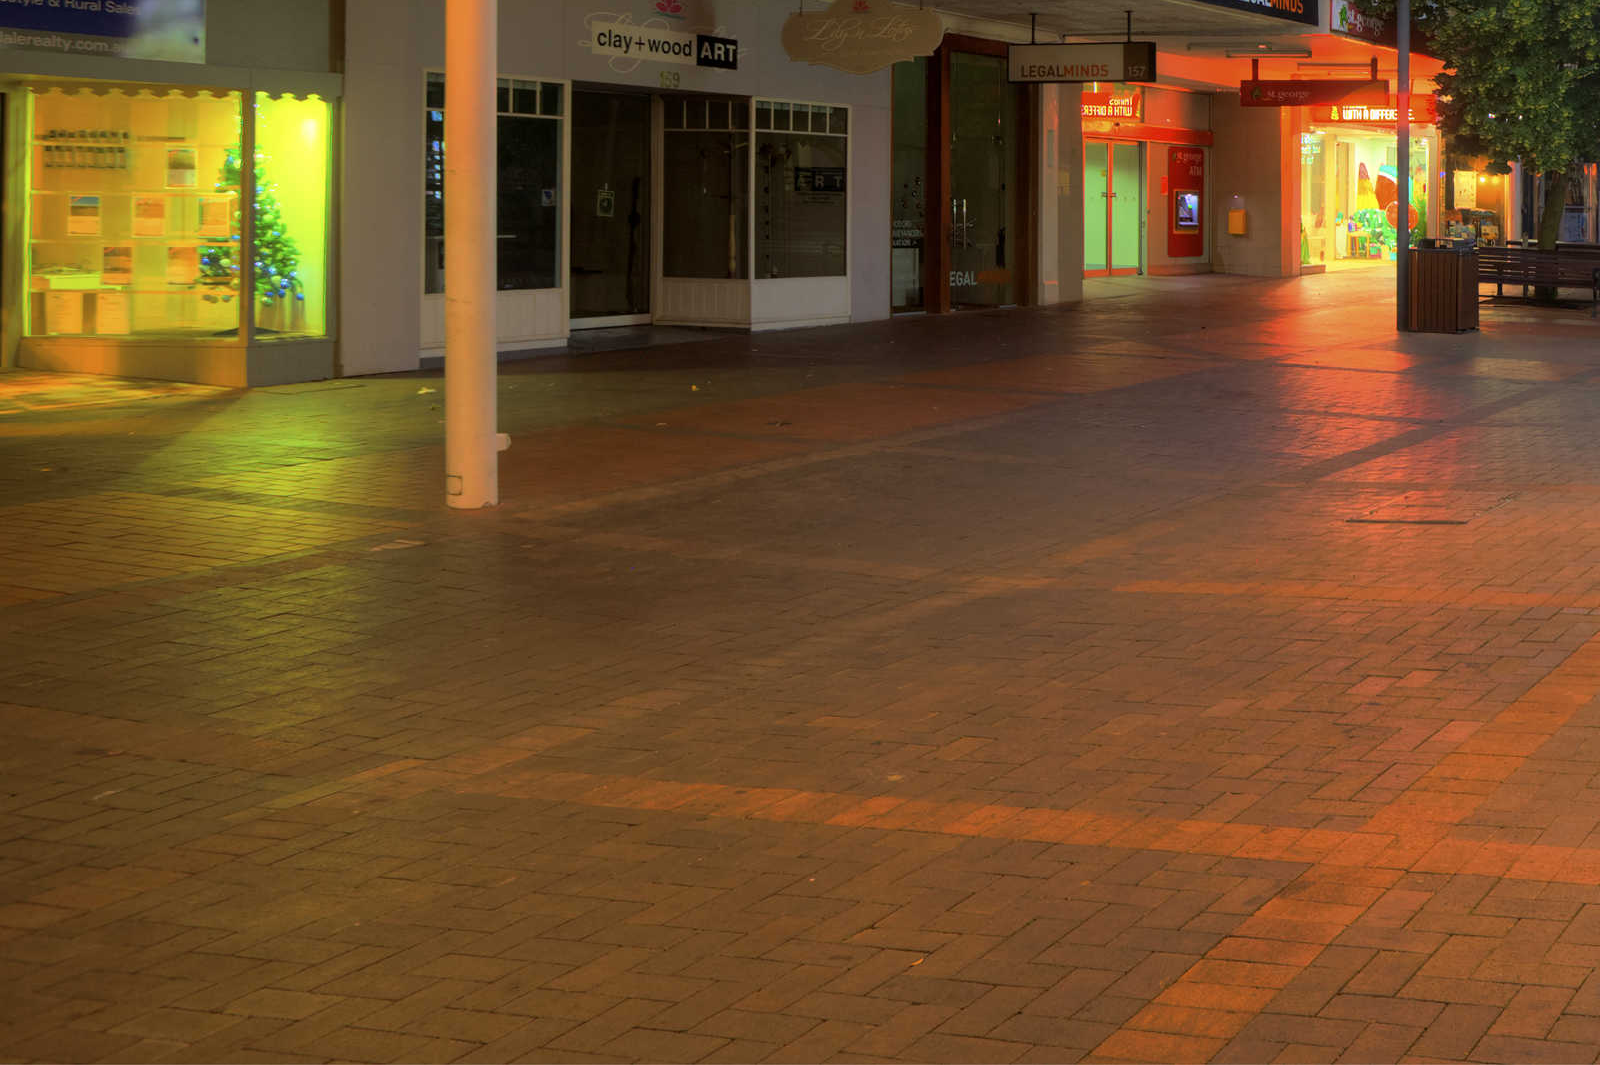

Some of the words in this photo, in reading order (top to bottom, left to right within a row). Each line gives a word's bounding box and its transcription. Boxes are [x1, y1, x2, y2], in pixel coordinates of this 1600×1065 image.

[597, 29, 692, 57] clay+wood
[701, 42, 737, 63] ART
[1021, 64, 1109, 78] LEGALMINDS
[1128, 66, 1146, 77] 157
